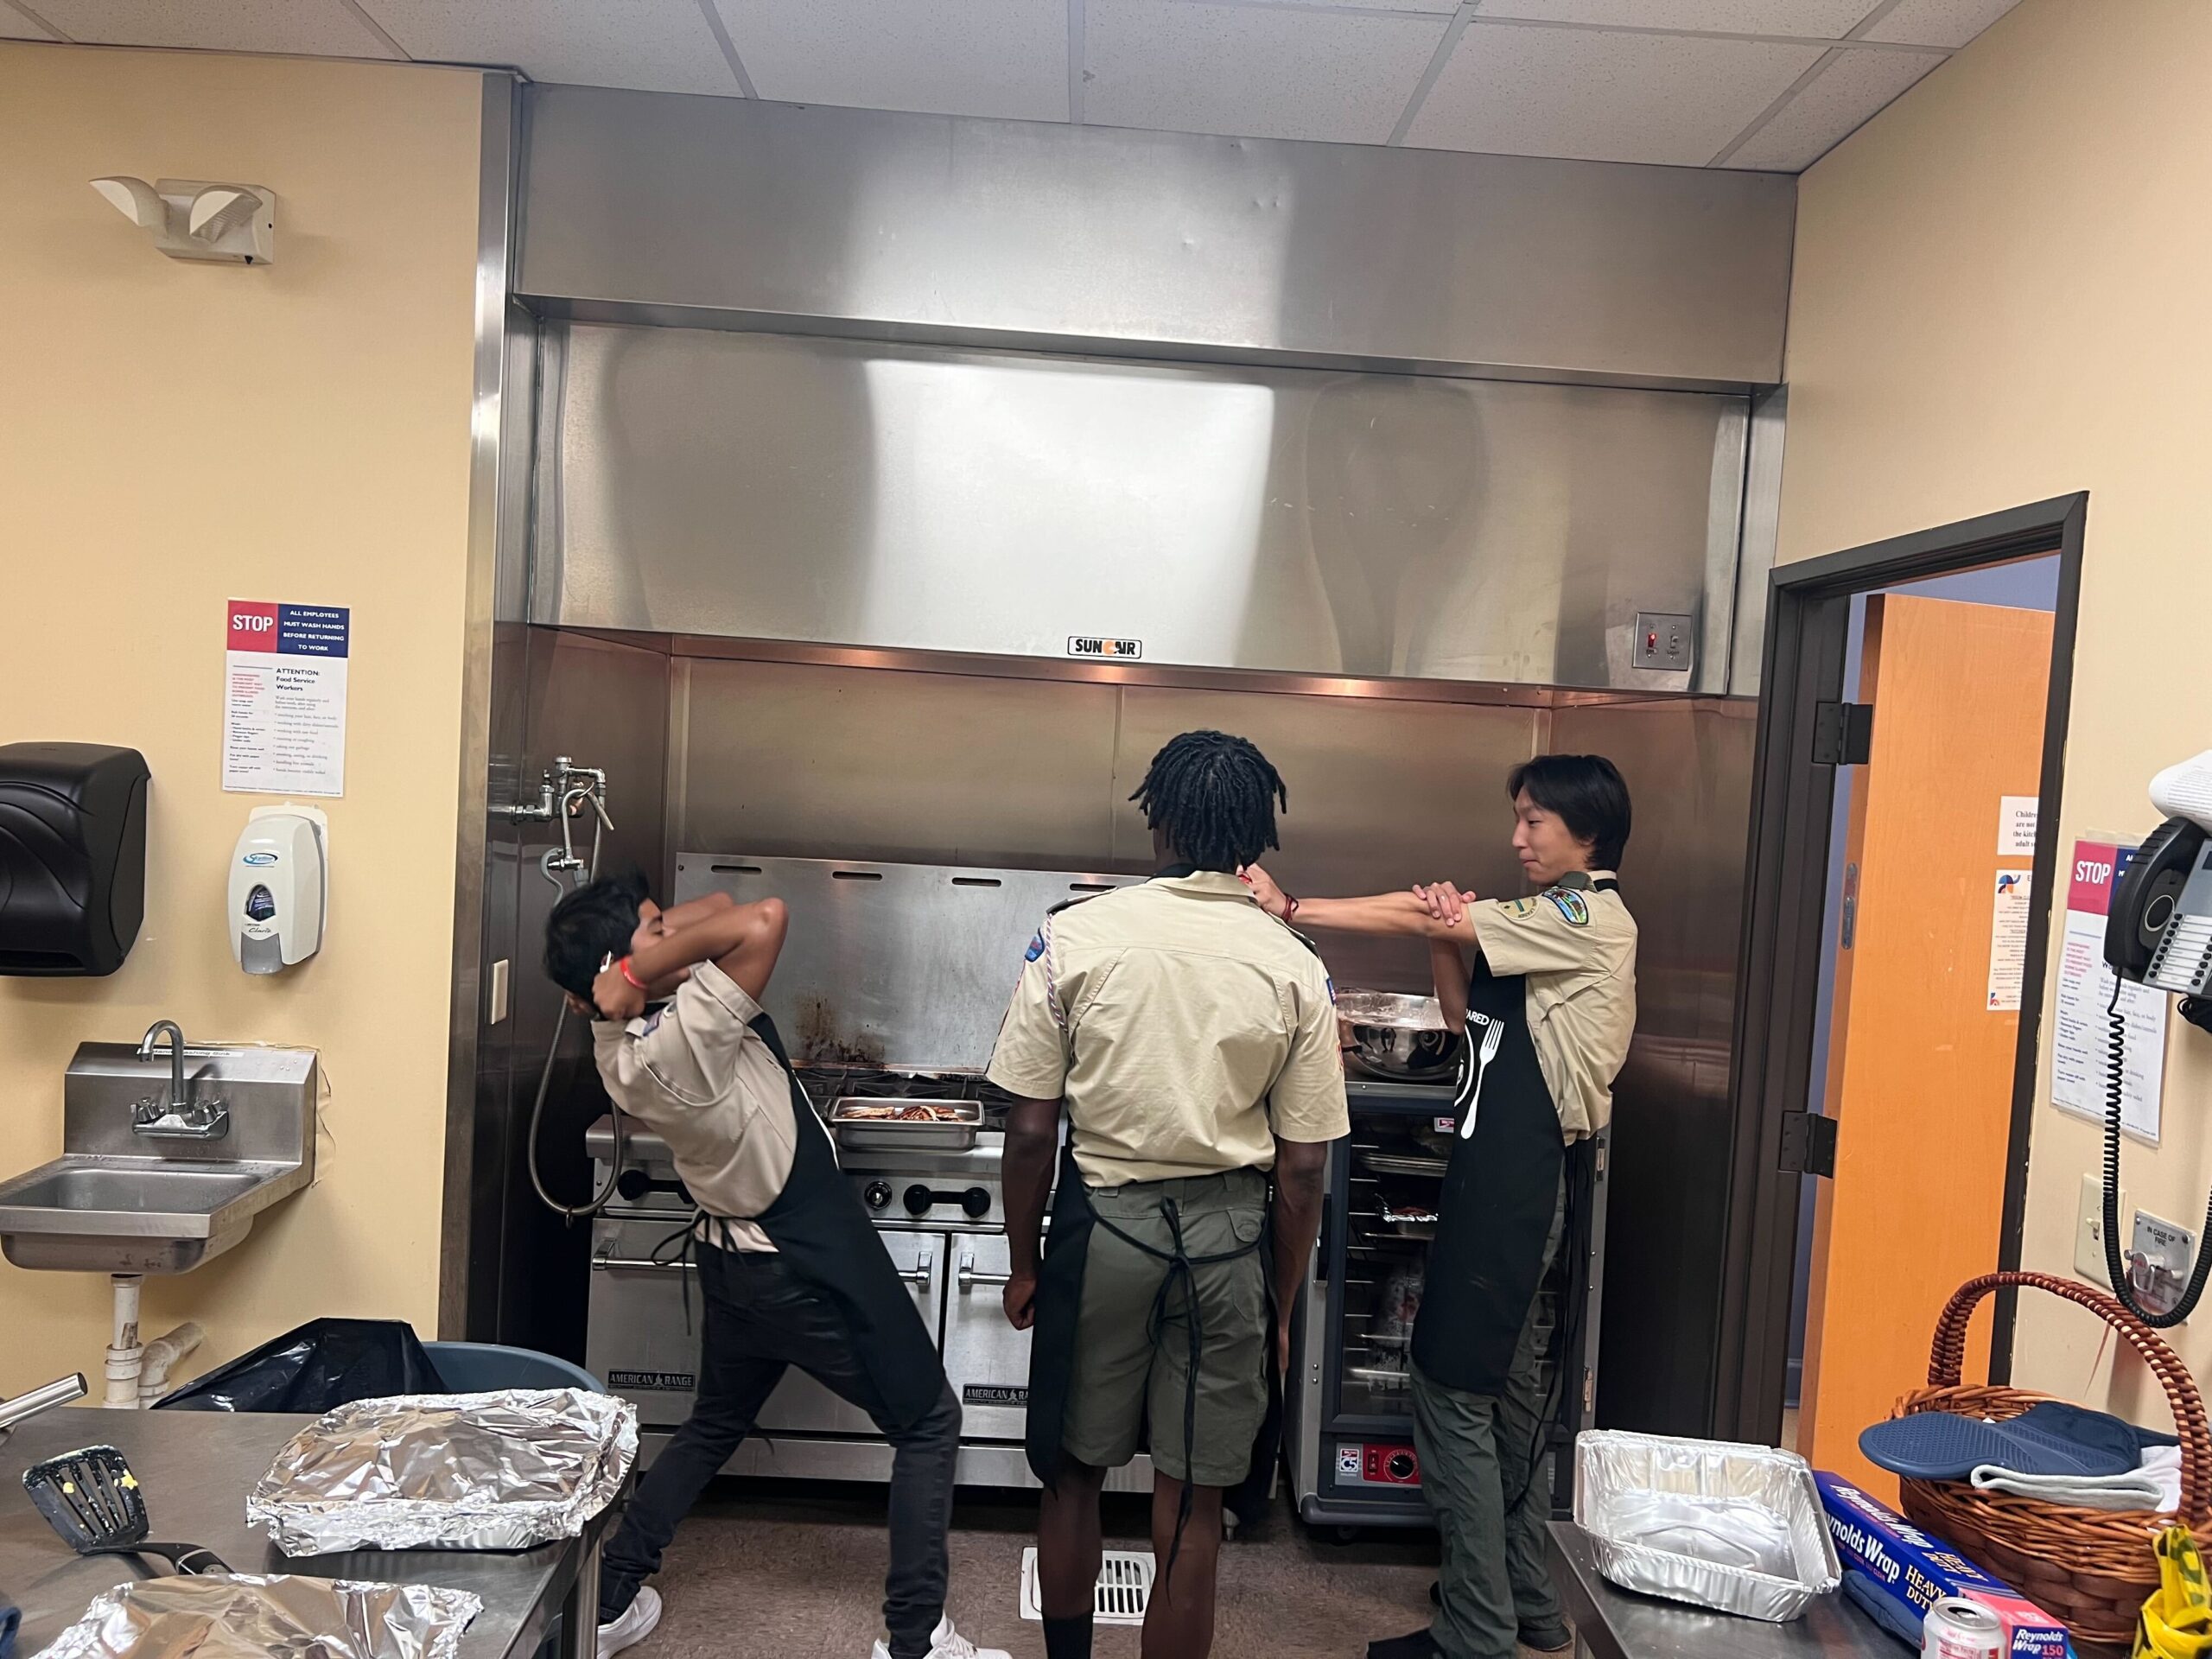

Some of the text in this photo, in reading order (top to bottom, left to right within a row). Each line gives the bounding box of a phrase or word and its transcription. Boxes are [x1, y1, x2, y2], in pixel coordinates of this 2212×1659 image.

[232, 614, 274, 632] STOP
[1075, 639, 1103, 653] SUN
[2075, 860, 2112, 885] STOP
[1465, 1007, 1490, 1027] ARED
[2146, 1225, 2176, 1243] IN CASE OF
[610, 1373, 692, 1386] AMERICAN RANGE
[965, 1389, 1007, 1400] AMERICAN
[1829, 1484, 1935, 1549] Reynolds Wrap
[1827, 1514, 1900, 1584] ynolds Wrap
[1904, 1564, 1947, 1600] HEAVY
[2015, 1628, 2064, 1643] Reynolds
[2012, 1639, 2042, 1655] Wrap
[2042, 1644, 2064, 1656] 150
